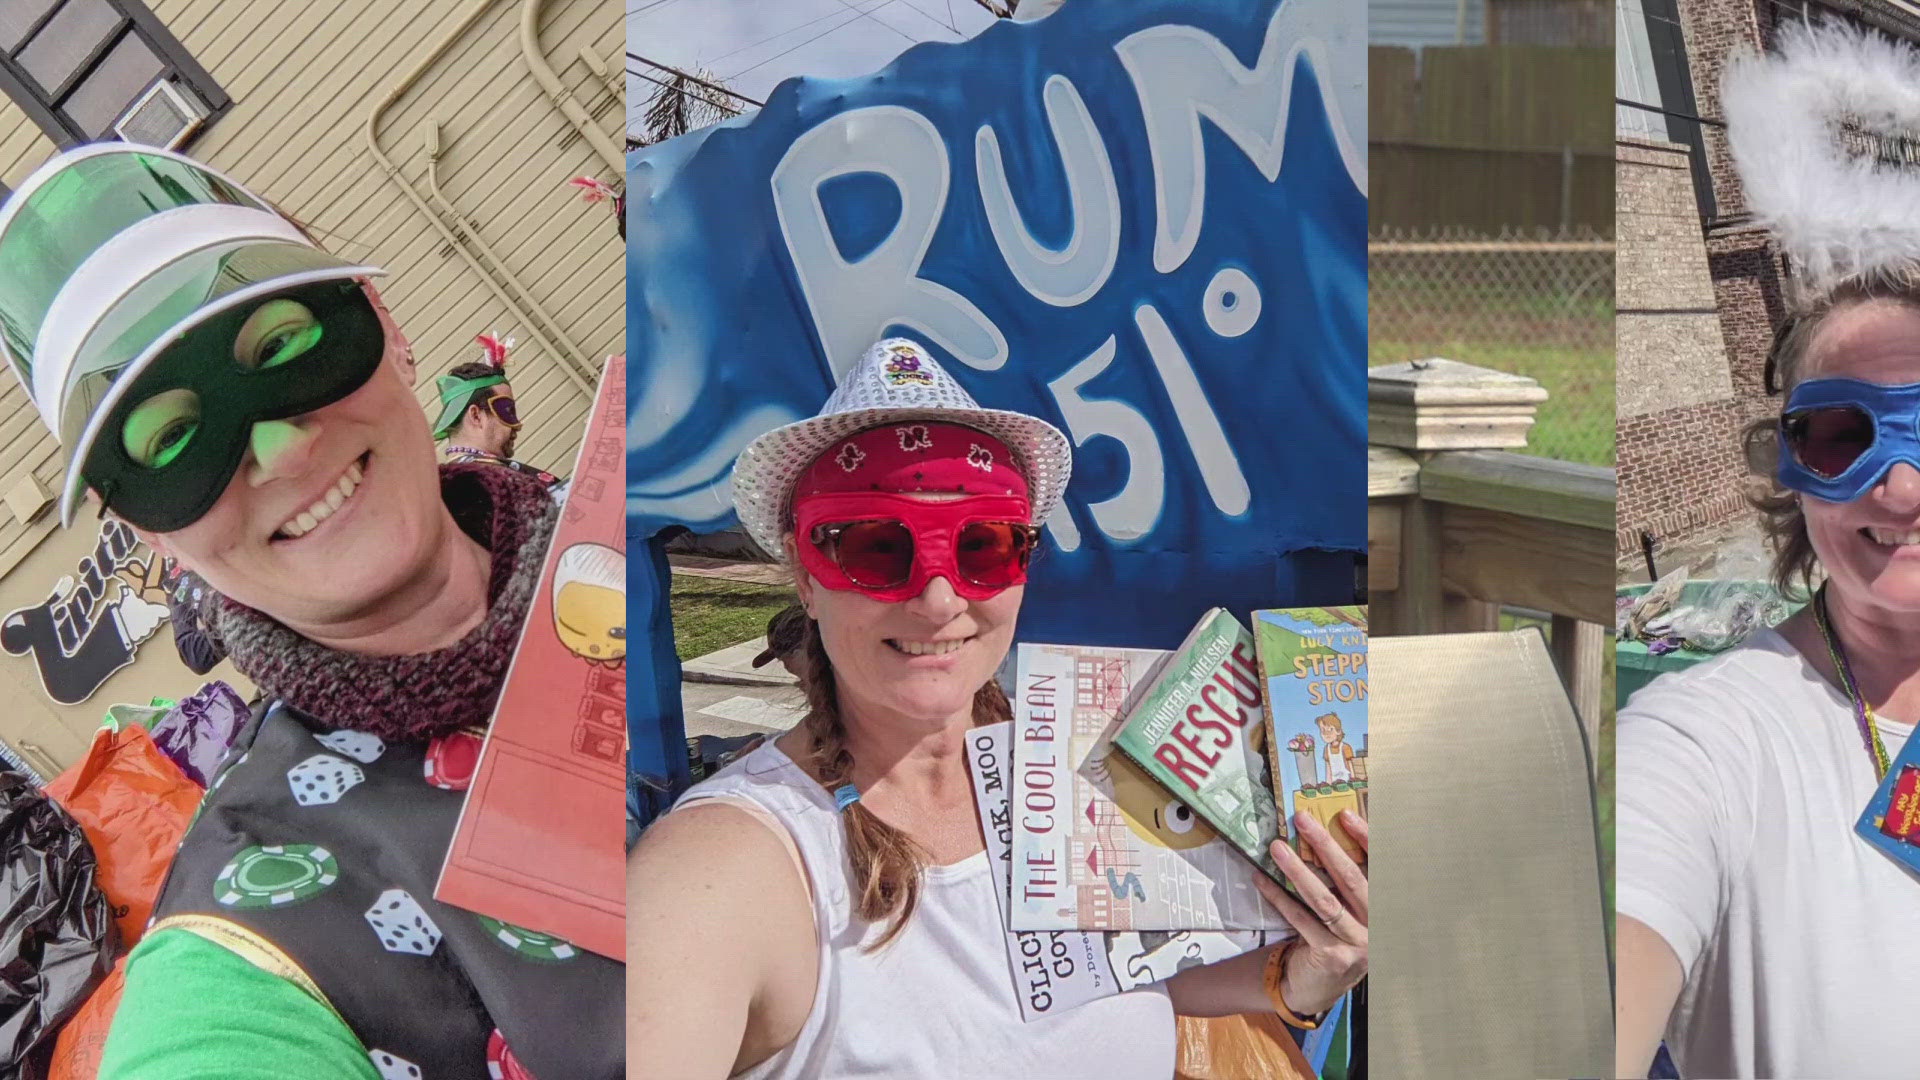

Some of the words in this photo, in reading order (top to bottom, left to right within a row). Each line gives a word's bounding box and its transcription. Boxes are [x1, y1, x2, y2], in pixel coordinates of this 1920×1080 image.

[772, 0, 1368, 391] RUM
[1300, 632, 1335, 648] LUCY
[1024, 673, 1058, 743] BEAN
[1142, 686, 1188, 746] JENNIFER
[1188, 632, 1232, 684] NIELSEN
[975, 735, 1003, 794] MOO
[1022, 755, 1057, 834] COOL
[1023, 848, 1058, 903] THE
